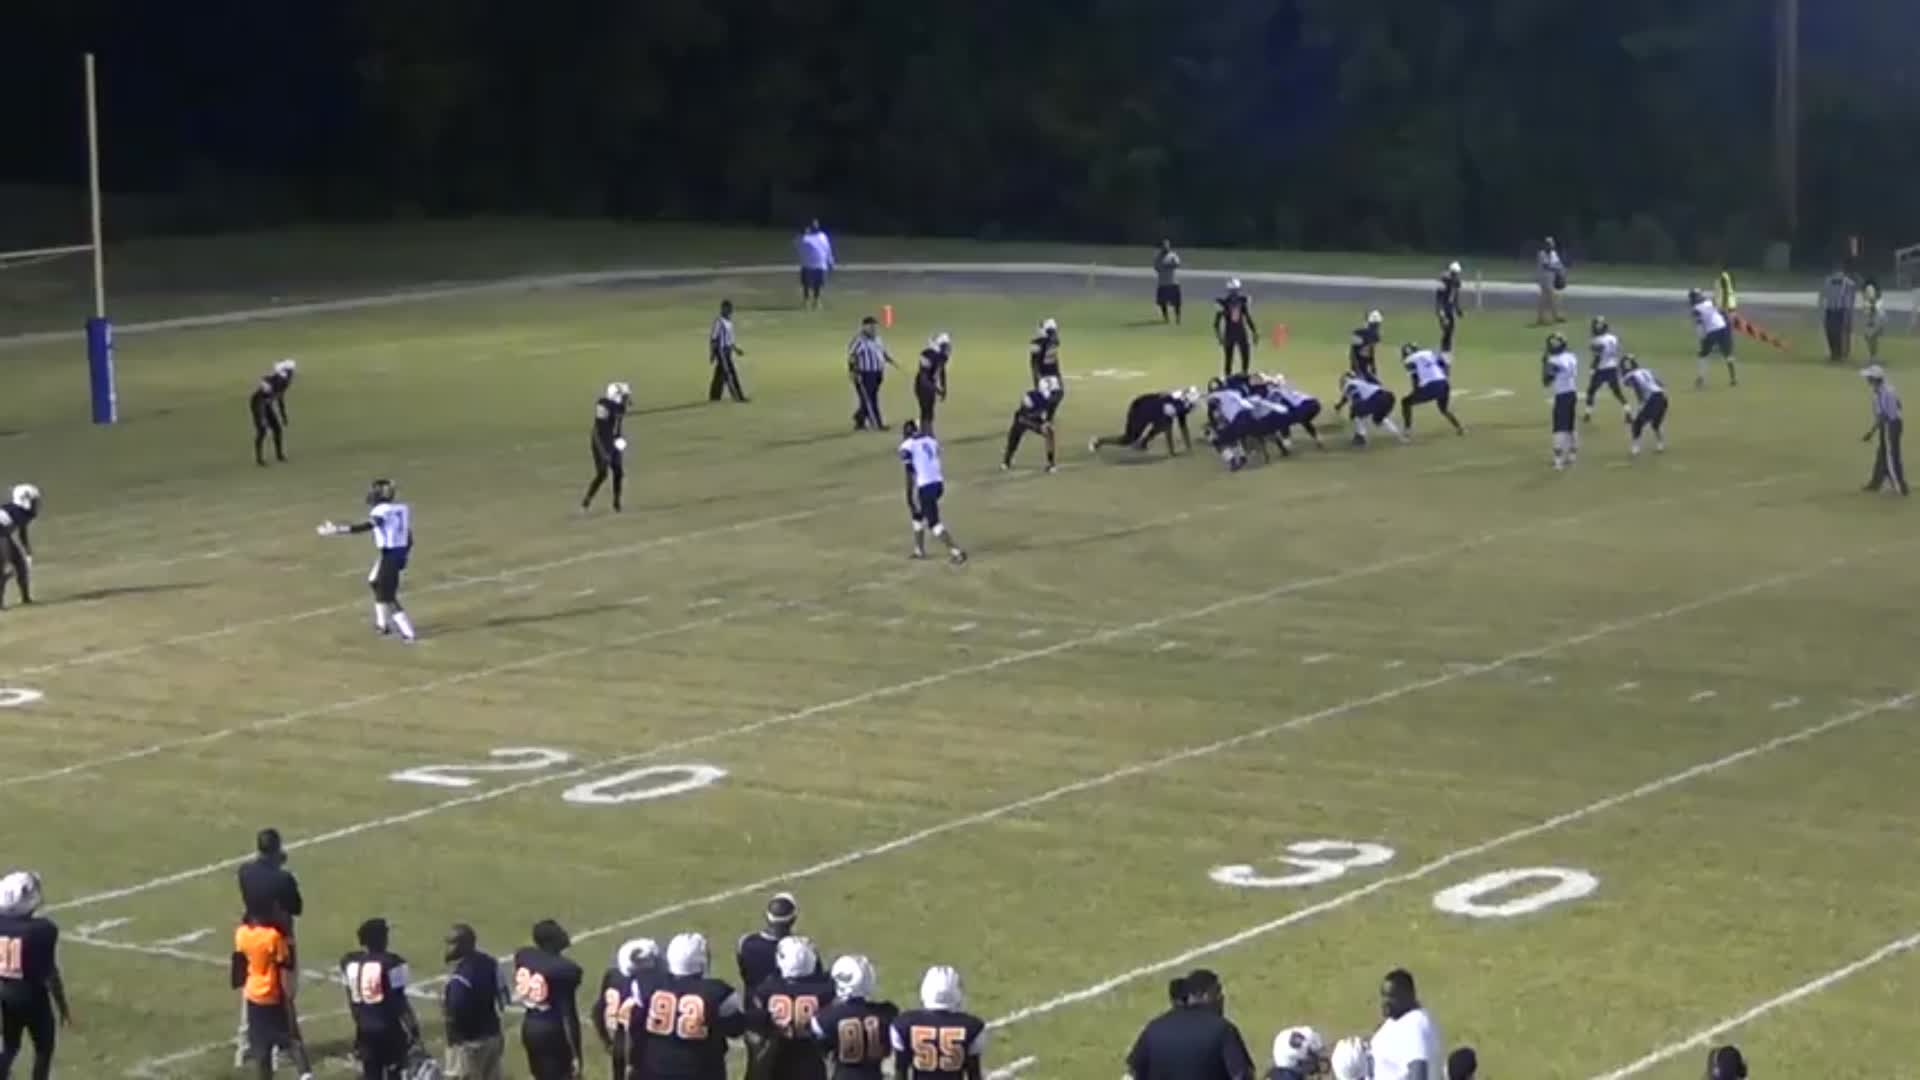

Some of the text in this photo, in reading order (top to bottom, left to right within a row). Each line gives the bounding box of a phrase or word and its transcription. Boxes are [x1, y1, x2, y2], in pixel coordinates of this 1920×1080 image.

[389, 746, 727, 804] 20
[1208, 839, 1600, 917] 30
[646, 990, 707, 1038] 92
[911, 1026, 966, 1071] 55
